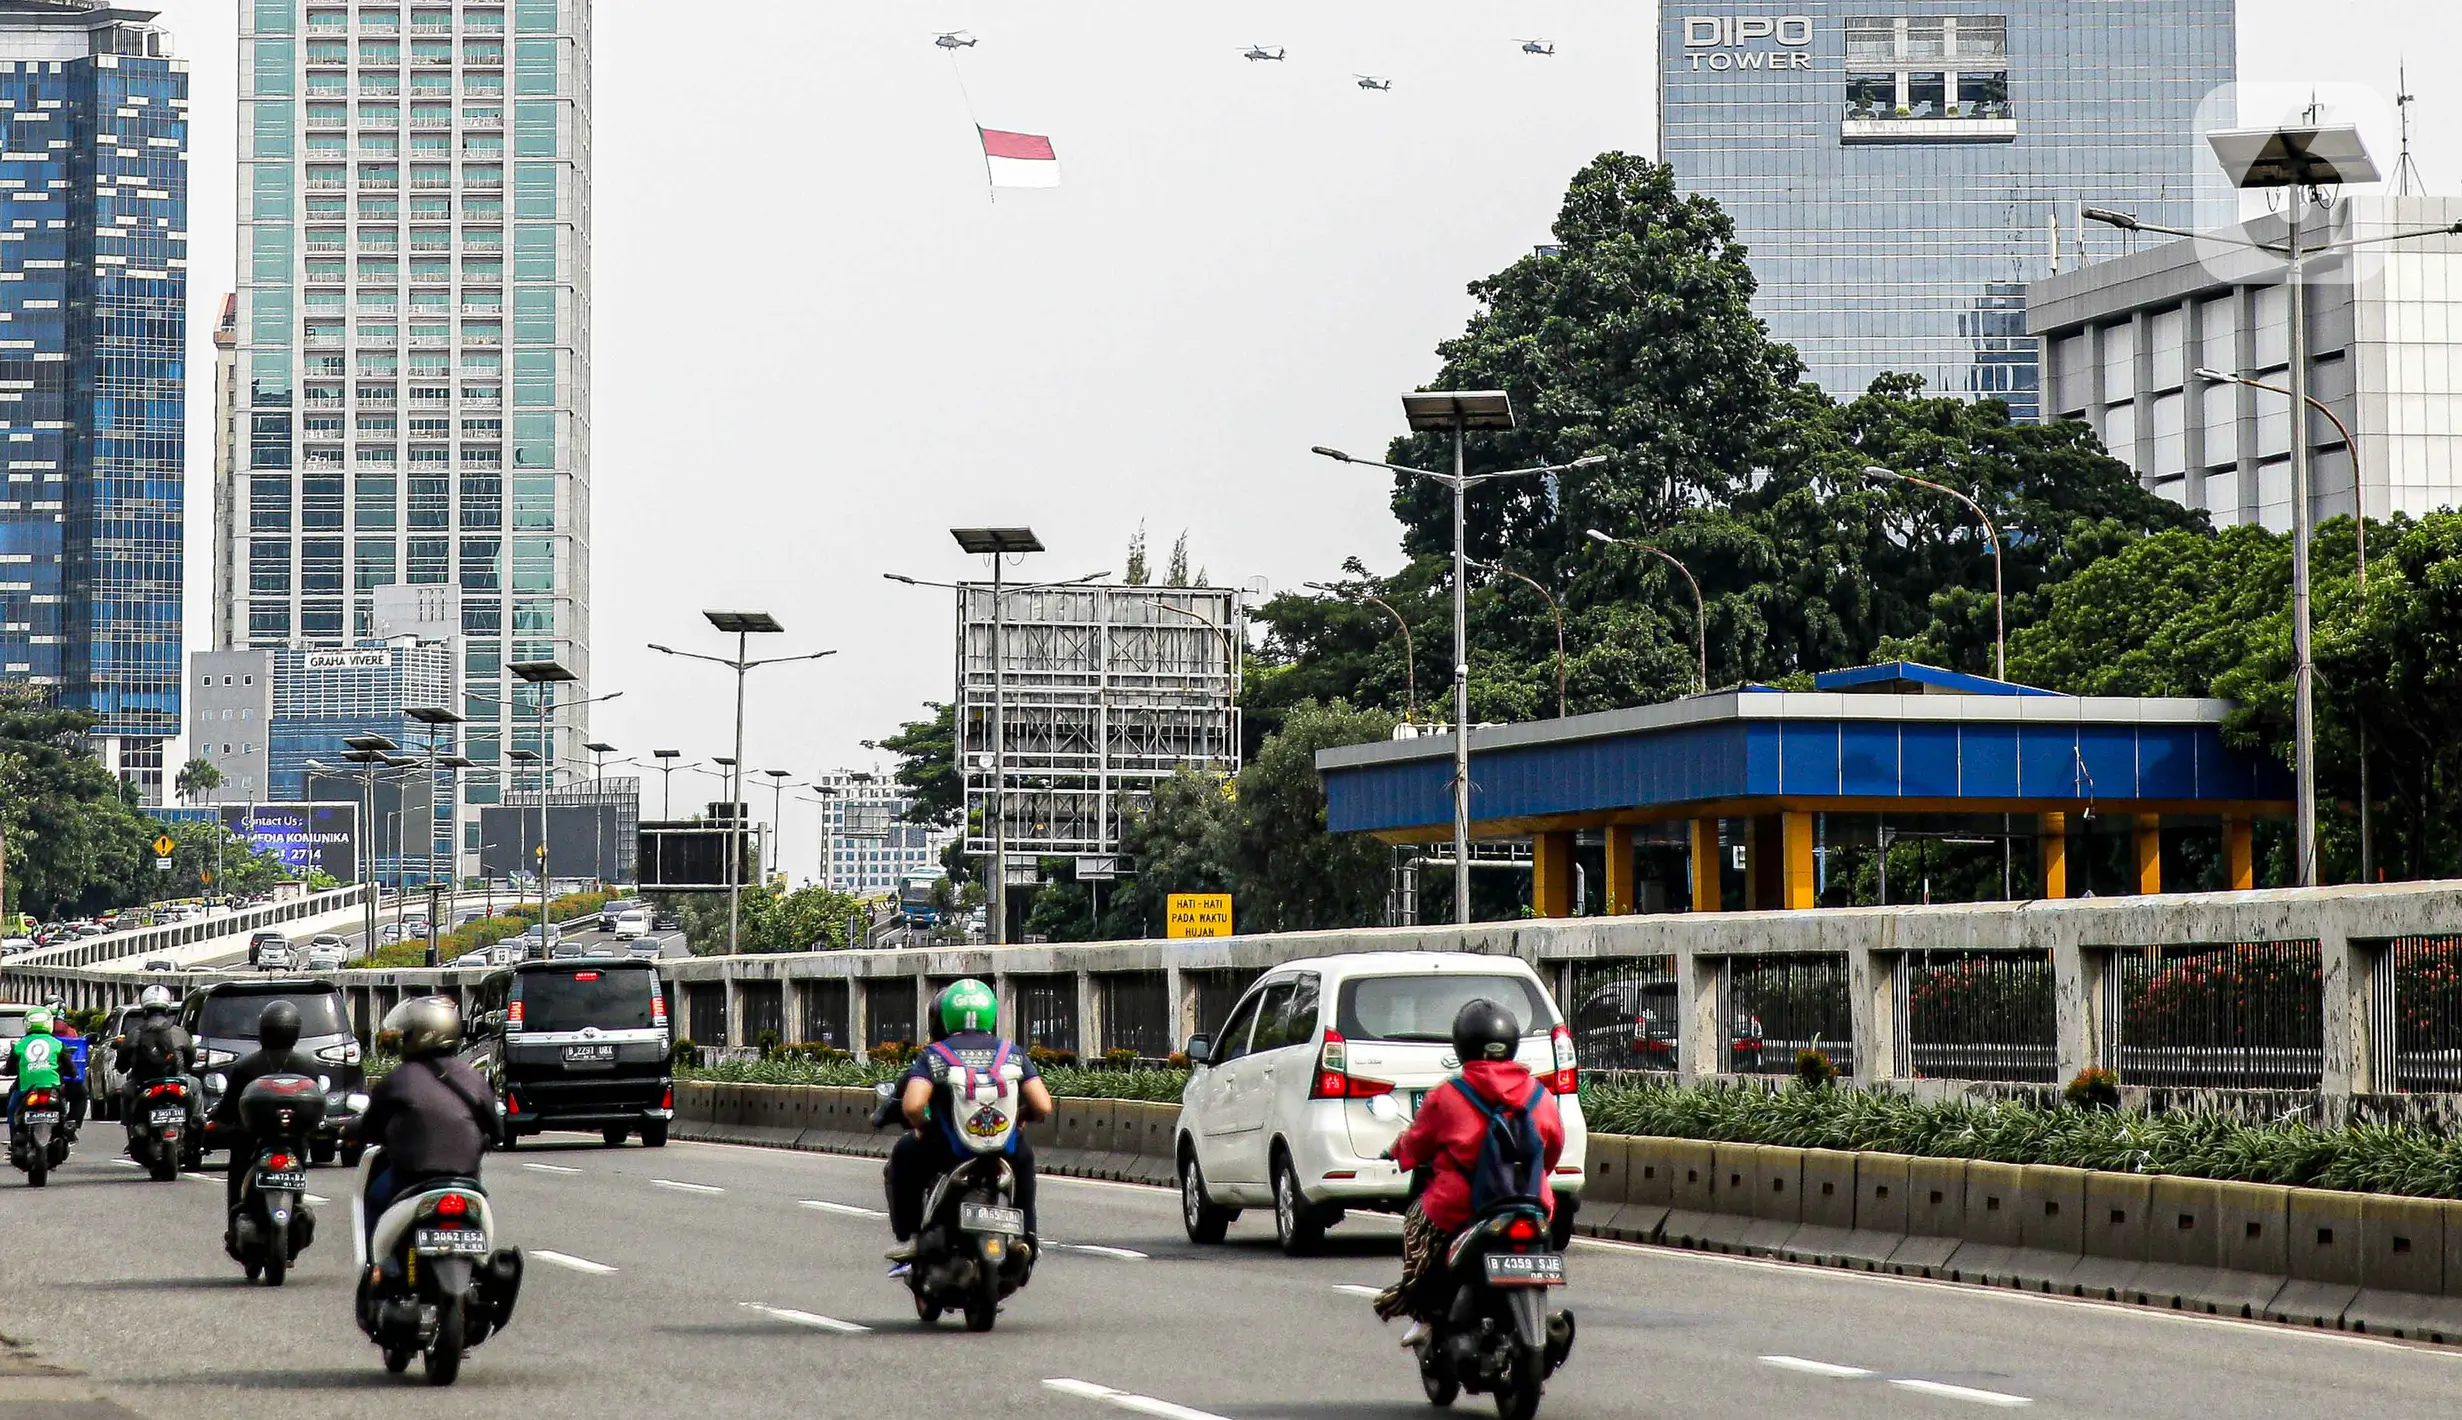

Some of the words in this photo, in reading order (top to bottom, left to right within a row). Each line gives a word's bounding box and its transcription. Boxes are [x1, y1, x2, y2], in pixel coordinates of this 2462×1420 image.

[1684, 15, 1813, 47] DIPO
[1684, 51, 1812, 71] TOWER
[310, 657, 345, 667] GRAHA
[349, 655, 384, 666] VIVERE
[247, 833, 285, 844] MEDIA
[286, 832, 350, 844] KOMUNIKA
[1176, 899, 1196, 909] HATI
[1203, 899, 1223, 909] HATI
[1171, 913, 1195, 923] PADA
[1199, 913, 1228, 923] WAKTU
[1185, 927, 1215, 937] HUJAN
[568, 1046, 574, 1055] B
[421, 1232, 428, 1241] B
[1491, 1258, 1498, 1269] B
[1504, 1258, 1532, 1269] 4359
[1538, 1258, 1560, 1269] SJE
